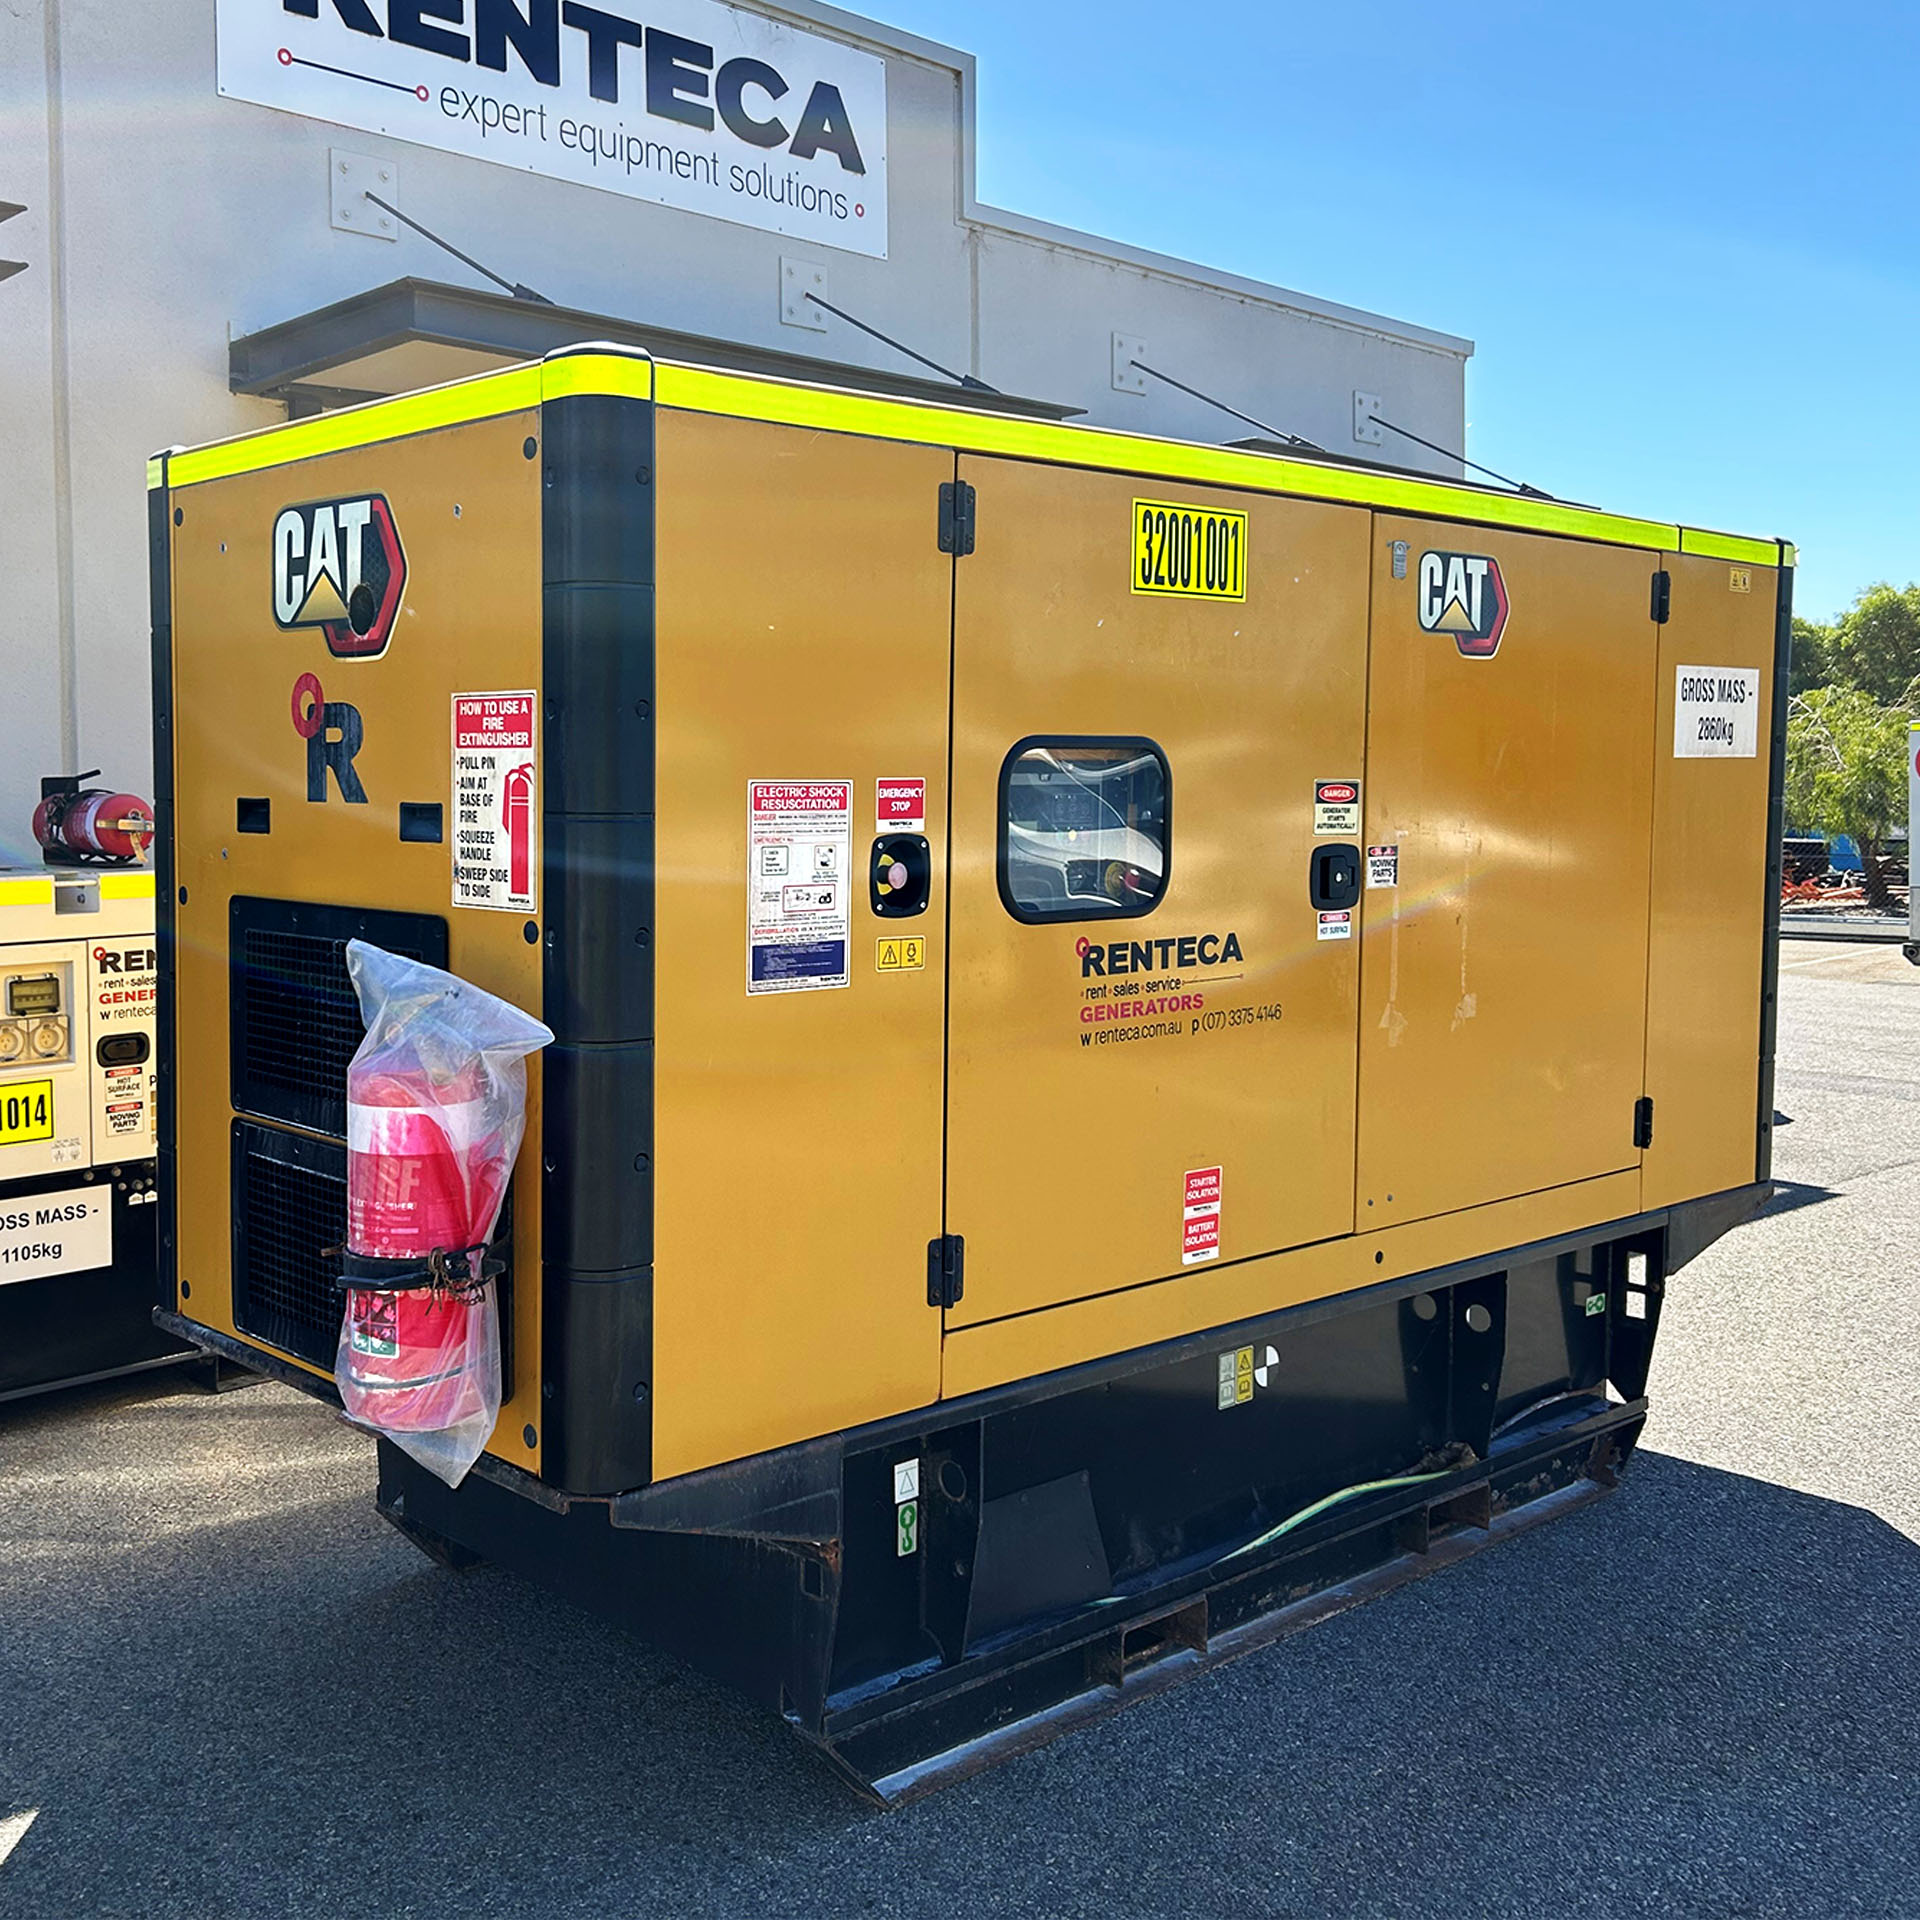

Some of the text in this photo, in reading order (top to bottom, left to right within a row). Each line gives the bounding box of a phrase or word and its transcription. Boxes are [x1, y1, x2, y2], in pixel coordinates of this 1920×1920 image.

[440, 85, 848, 221] expert equipment solutions
[1142, 509, 1239, 592] 32001001
[274, 500, 372, 624] CAT
[1420, 552, 1488, 632] CAT
[1681, 677, 1715, 702] GROSS
[1717, 678, 1746, 704] MASS
[460, 700, 529, 715] HOW TO USE A
[483, 717, 504, 730] FIRE
[460, 731, 530, 746] EXTINGUISHER
[1698, 717, 1734, 746] 2860kg
[460, 756, 496, 769] PULL PIN
[460, 777, 488, 789] AIM AT
[757, 786, 844, 797] ELECTRIC SHOCK
[879, 787, 923, 798] EMERGENCY
[1323, 789, 1350, 798] DANGER
[460, 794, 494, 807] BASE OF
[761, 798, 840, 809] RESUSCITATION
[891, 801, 911, 812] STOP
[460, 810, 478, 823] FIRE
[460, 830, 495, 844] SQUEEZE
[460, 847, 491, 861] HANDLE
[460, 866, 508, 882] SWEEP SIDE
[460, 883, 490, 898] TO SIDE
[1082, 932, 1243, 978] RENTECA
[104, 978, 124, 989] rent
[1086, 975, 1182, 1000] rent sales service
[100, 1011, 111, 1020] w
[1080, 993, 1204, 1024] GENERATORS
[1080, 1003, 1282, 1047] w renteca.com.au p (07) 3375 4146
[108, 1083, 140, 1093] SURFACE
[0, 1094, 47, 1132] 014
[110, 1111, 140, 1121] MOVING
[113, 1119, 138, 1128] PARTS
[1189, 1175, 1217, 1188] STARTER
[1186, 1187, 1219, 1200] ISOLATION
[36, 1204, 87, 1225] MASS
[1188, 1221, 1216, 1234] BATTERY
[1185, 1232, 1218, 1247] ISOLATION
[2, 1242, 62, 1264] 1105kg
